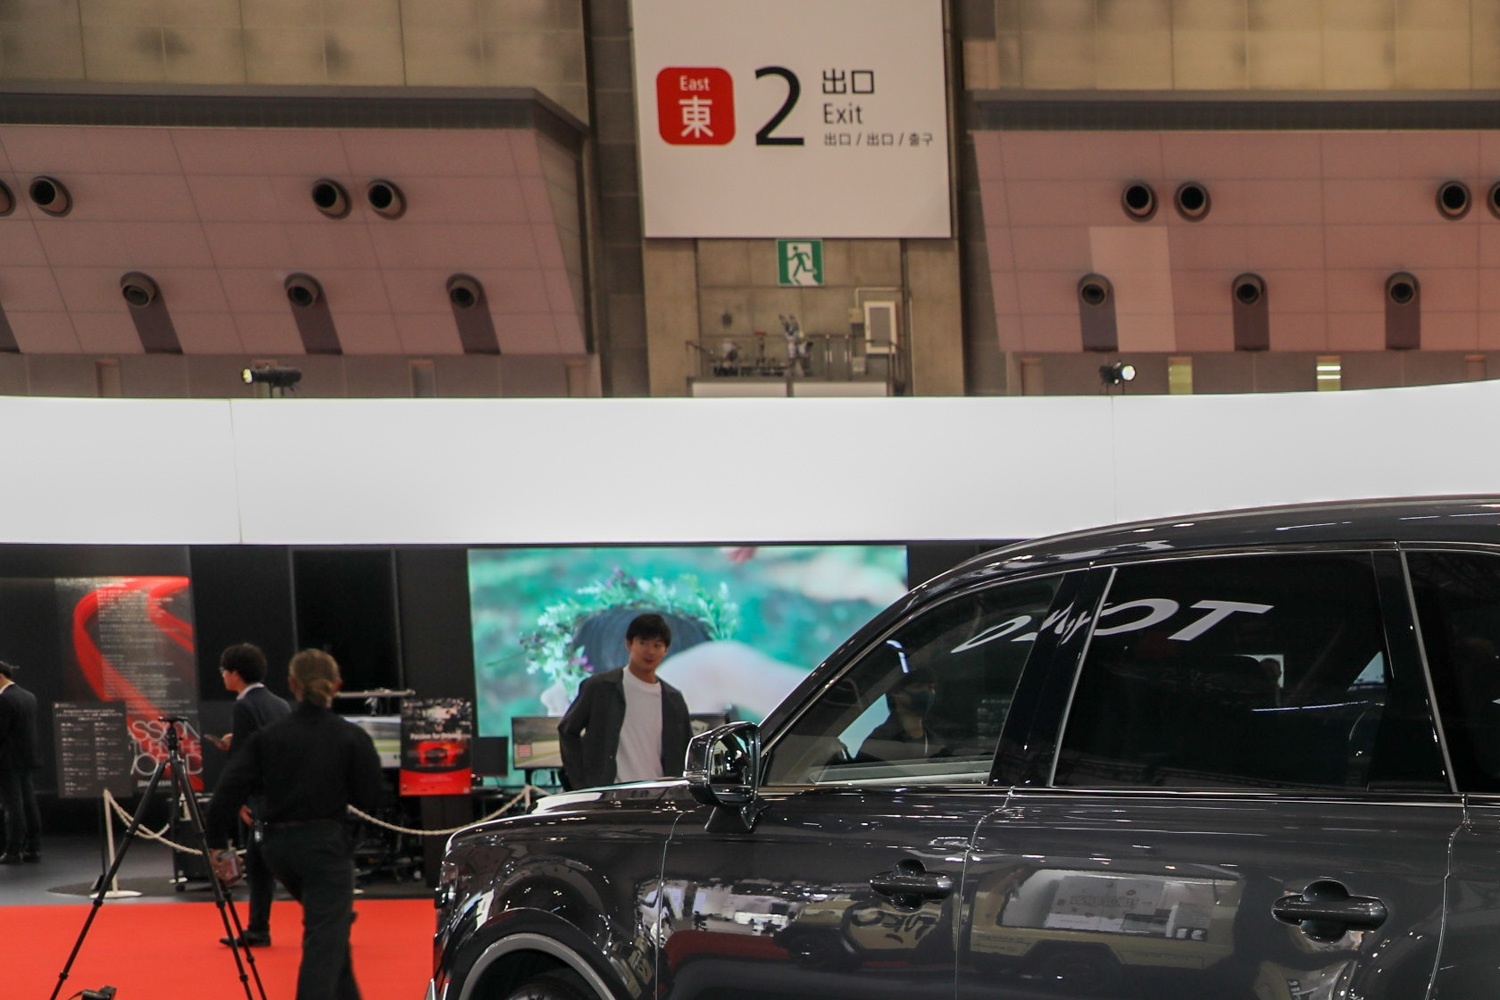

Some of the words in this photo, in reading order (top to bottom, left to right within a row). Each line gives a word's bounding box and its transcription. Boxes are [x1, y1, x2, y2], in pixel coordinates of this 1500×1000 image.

[679, 76, 710, 92] East
[822, 68, 875, 95] 出口
[678, 95, 714, 138] 東
[755, 66, 804, 146] 2
[823, 103, 863, 125] Exit
[824, 133, 851, 146] 出口
[866, 133, 893, 146] 出口
